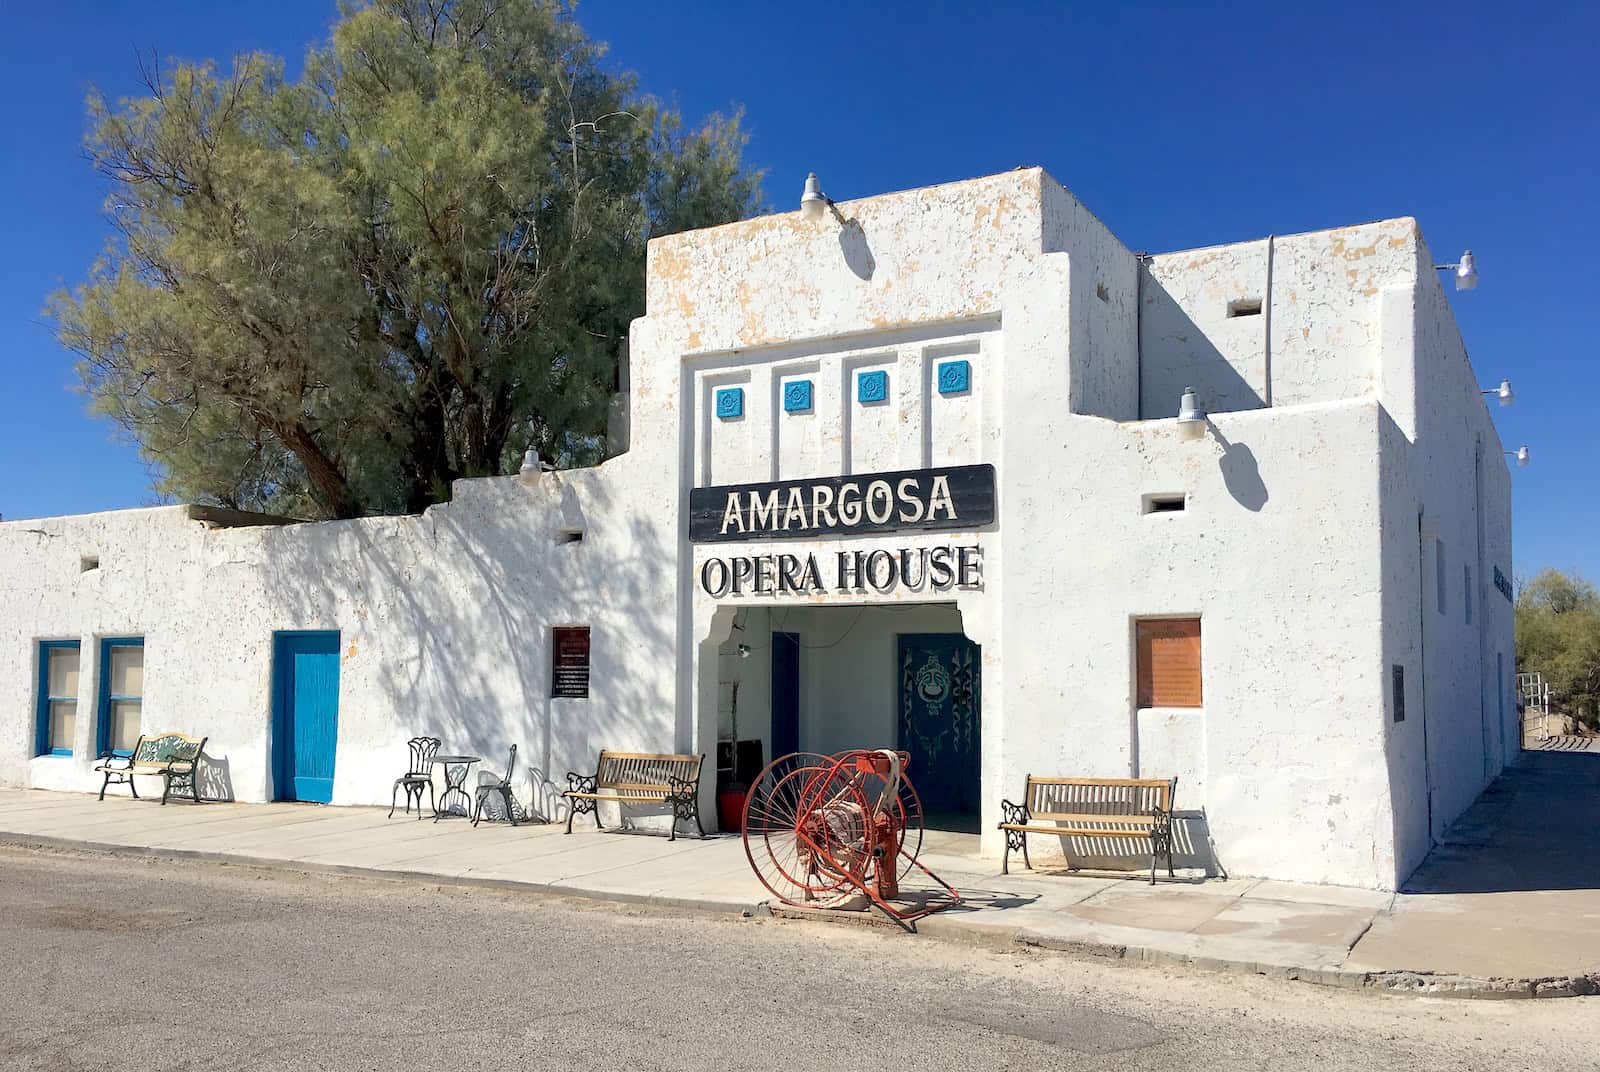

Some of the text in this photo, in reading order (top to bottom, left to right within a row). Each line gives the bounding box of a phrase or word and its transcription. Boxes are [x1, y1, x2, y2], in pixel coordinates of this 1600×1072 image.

[720, 475, 958, 535] AMARGOSA
[701, 543, 981, 596] OPERA HOUSE
